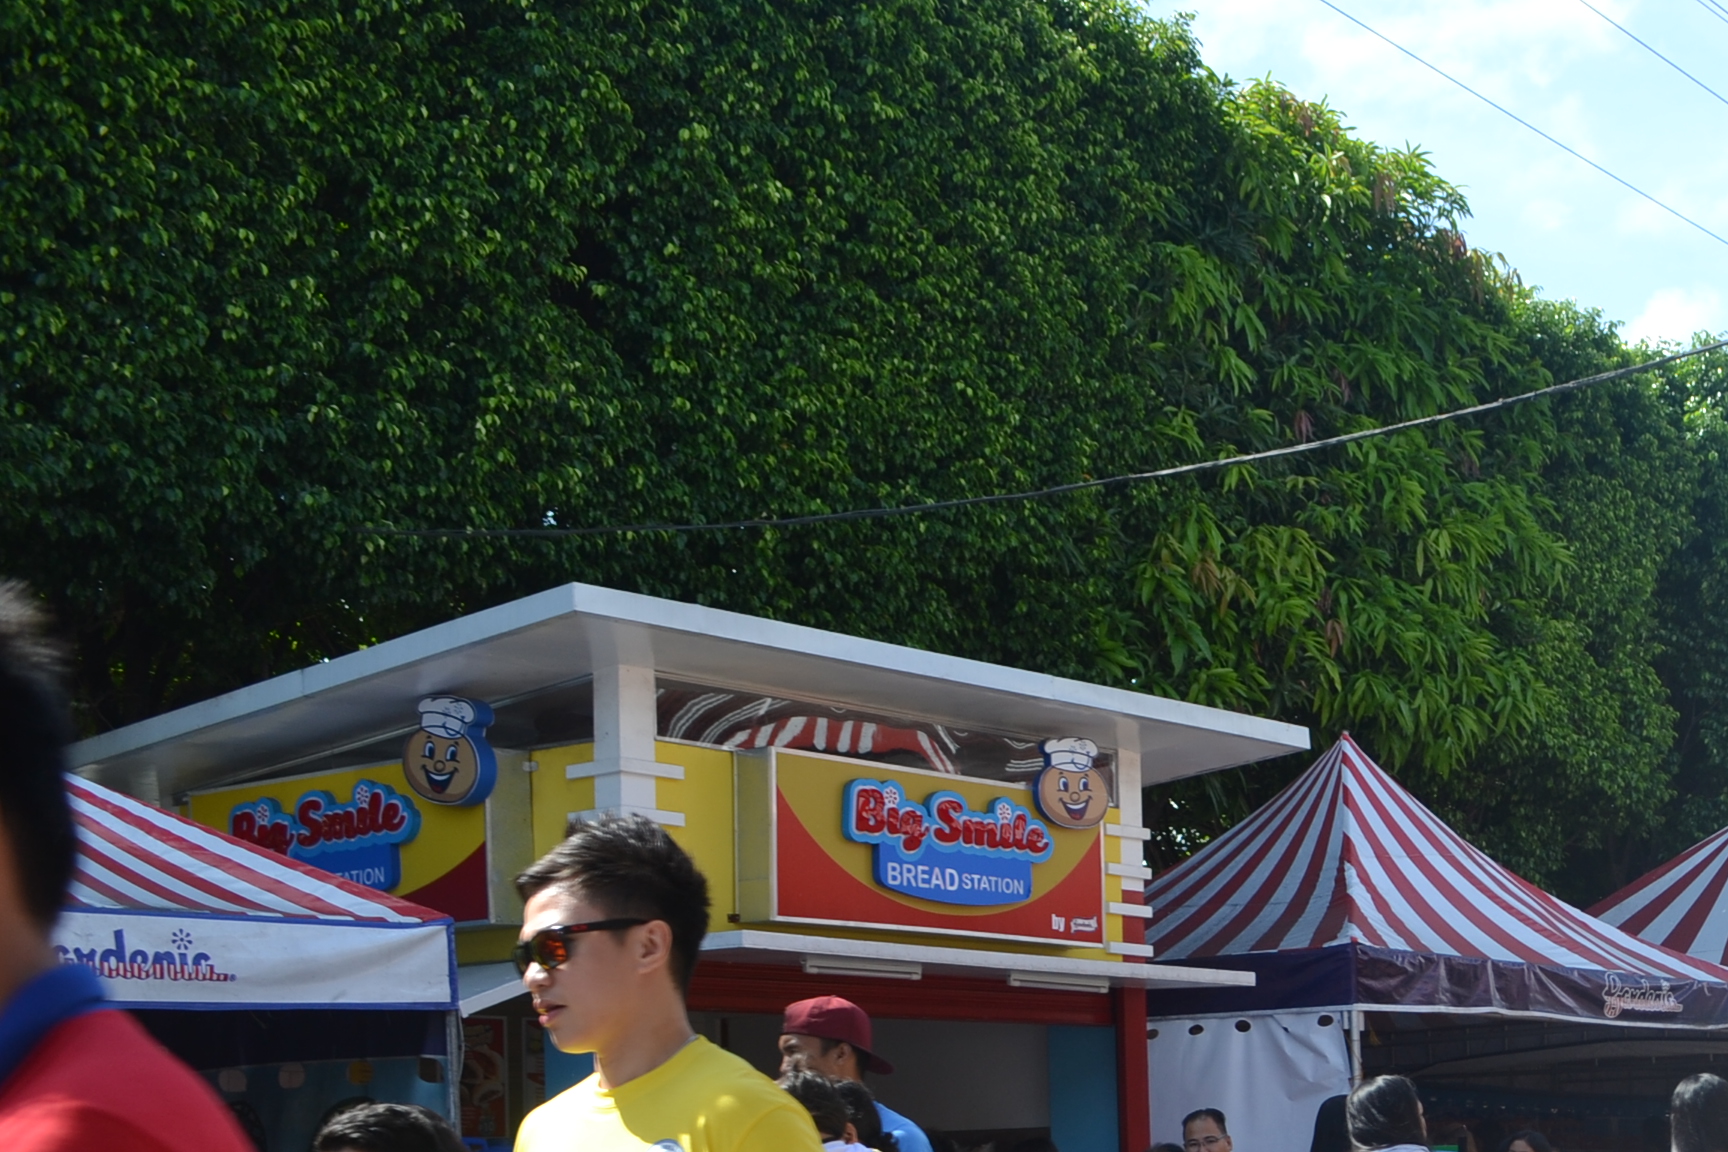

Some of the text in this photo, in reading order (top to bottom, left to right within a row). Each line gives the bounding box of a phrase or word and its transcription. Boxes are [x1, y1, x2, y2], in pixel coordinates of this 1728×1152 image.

[296, 785, 407, 847] Smile
[854, 787, 1050, 854] Big Smile
[886, 861, 1024, 895] BREAD STATION
[52, 929, 230, 982] ardenia
